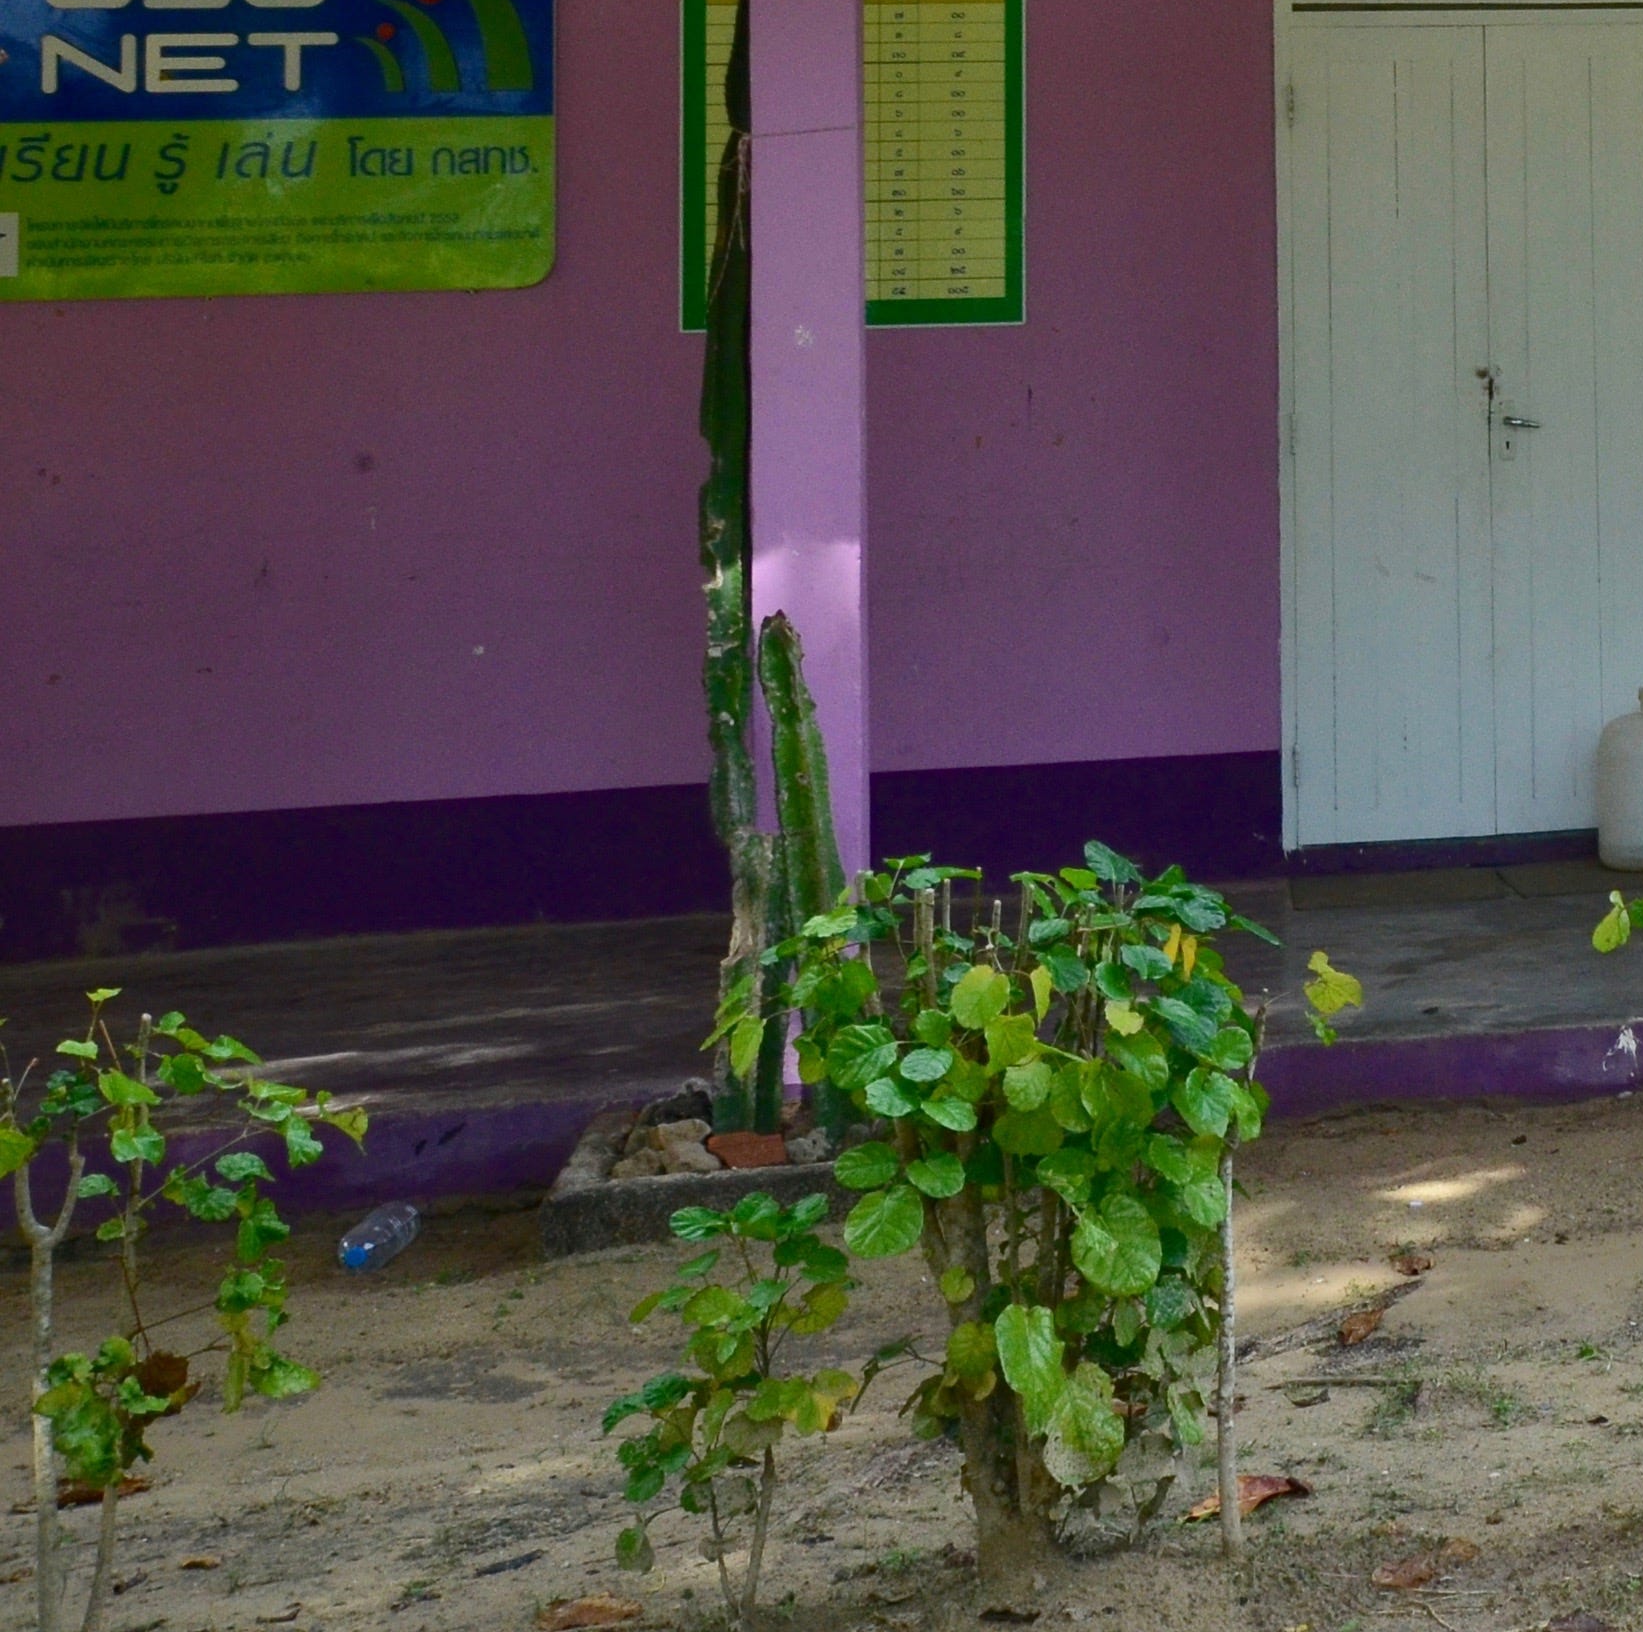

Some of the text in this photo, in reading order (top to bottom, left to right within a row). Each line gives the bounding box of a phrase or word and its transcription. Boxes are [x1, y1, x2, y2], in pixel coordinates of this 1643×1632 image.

[41, 31, 339, 95] NET
[154, 133, 191, 195] รู้
[215, 130, 317, 180] เล่น
[347, 135, 414, 177] โดย
[431, 145, 539, 177] กสทช.
